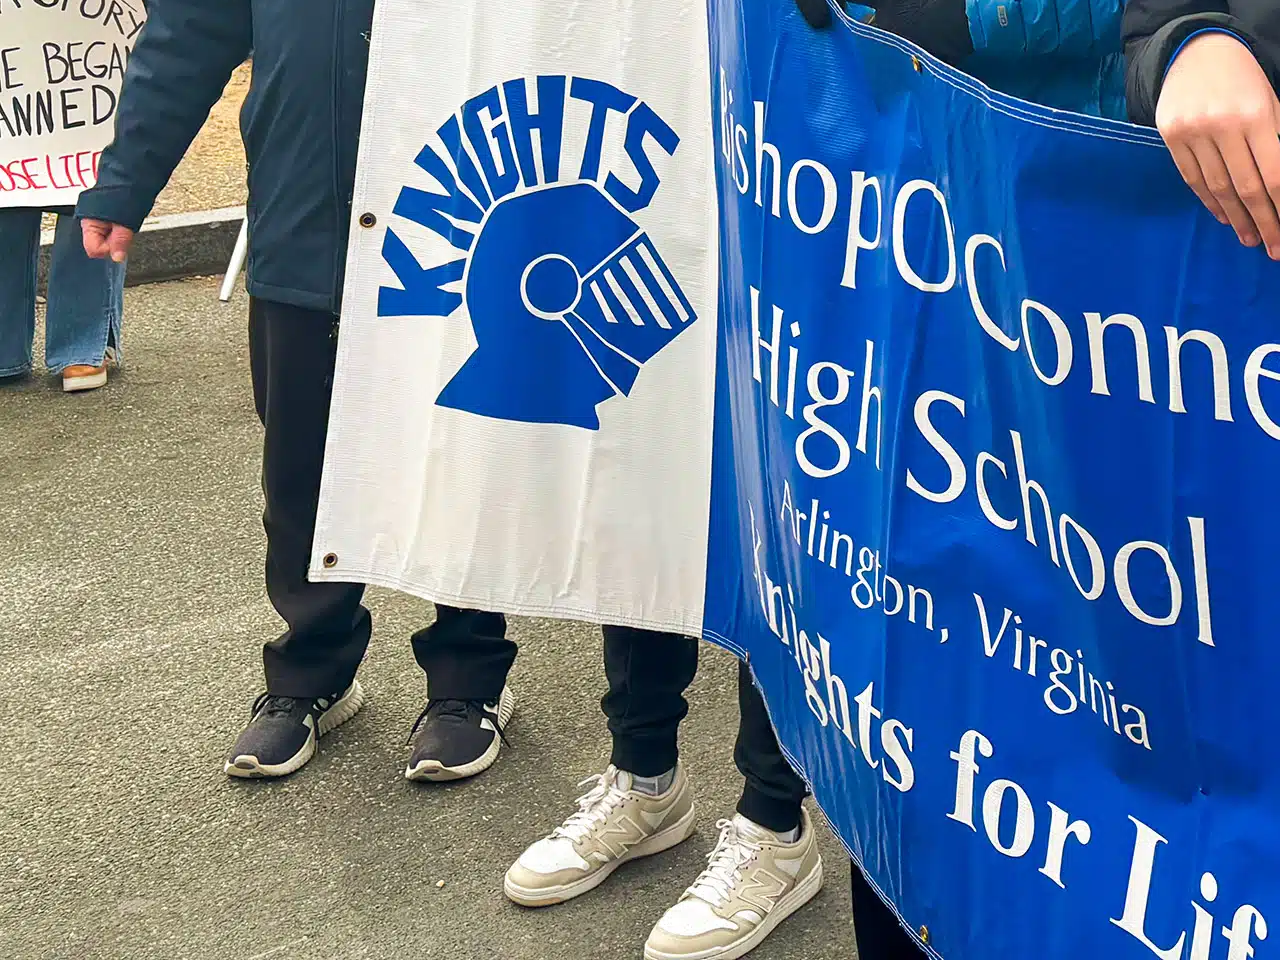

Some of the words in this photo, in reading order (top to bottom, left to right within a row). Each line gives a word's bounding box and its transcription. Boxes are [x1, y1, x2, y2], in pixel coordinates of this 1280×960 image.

[377, 74, 681, 318] KNIGHTS
[749, 284, 884, 479] High
[906, 389, 1216, 648] School
[780, 479, 950, 644] Arlington,
[973, 592, 1153, 752] Virginia
[747, 499, 915, 793] Knights
[945, 728, 1092, 891] for
